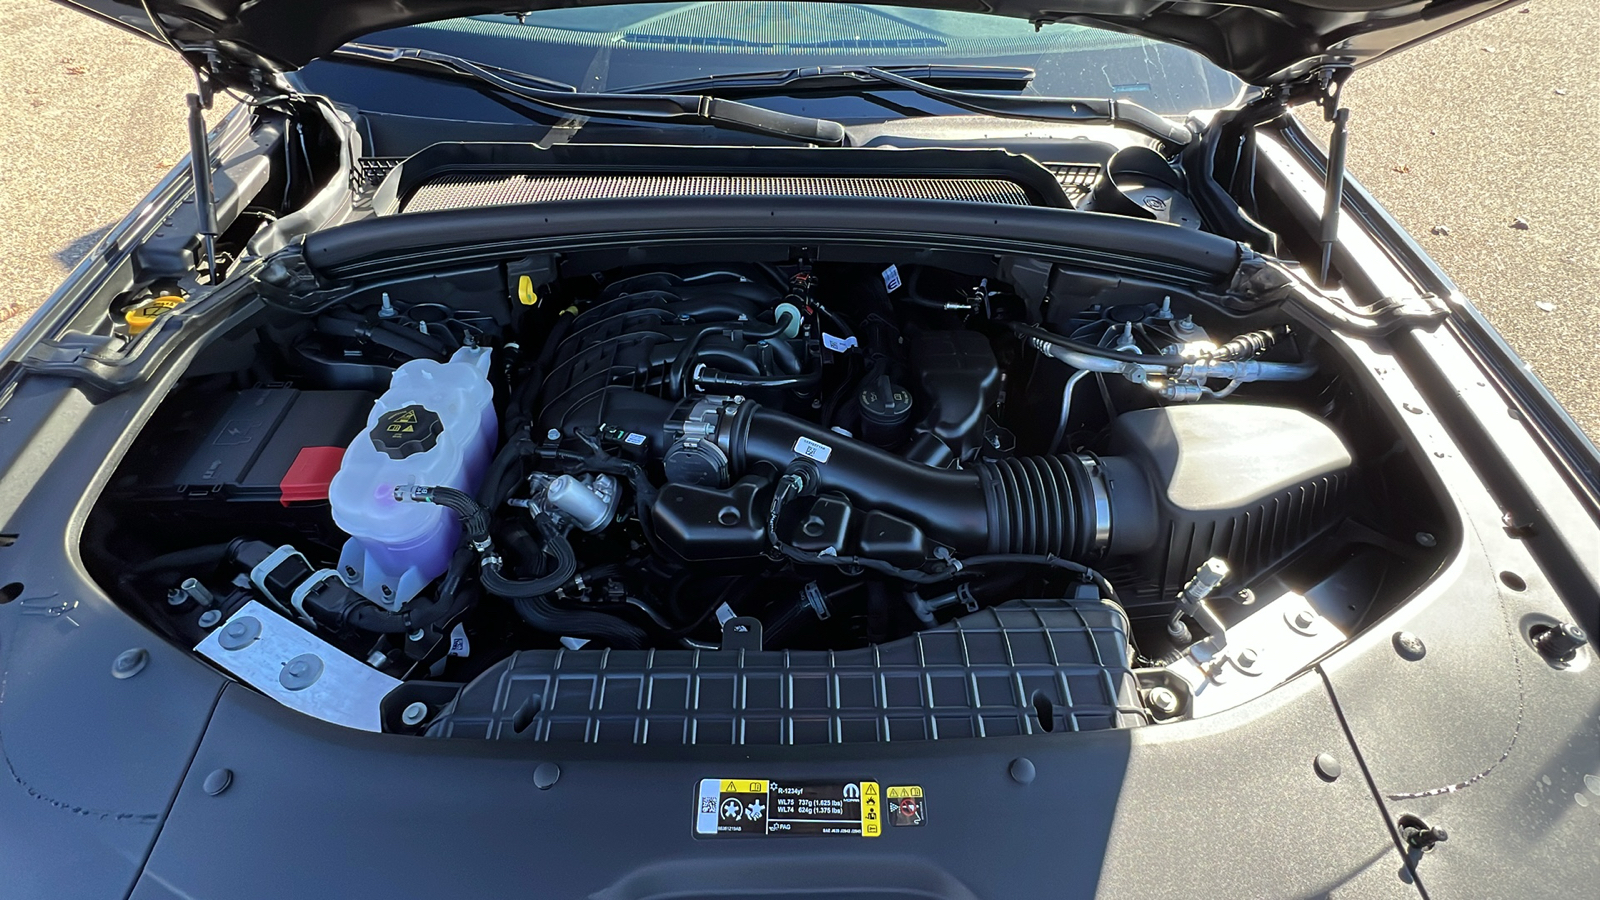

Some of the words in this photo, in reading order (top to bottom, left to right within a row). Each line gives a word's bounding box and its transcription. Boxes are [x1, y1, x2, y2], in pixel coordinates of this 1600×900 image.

[778, 787, 803, 796] R-1234yf
[798, 799, 812, 807] 737g
[831, 799, 843, 807] lbs)
[798, 806, 812, 814] 624g
[813, 807, 831, 815] (1.375
[831, 807, 843, 815] lbs)
